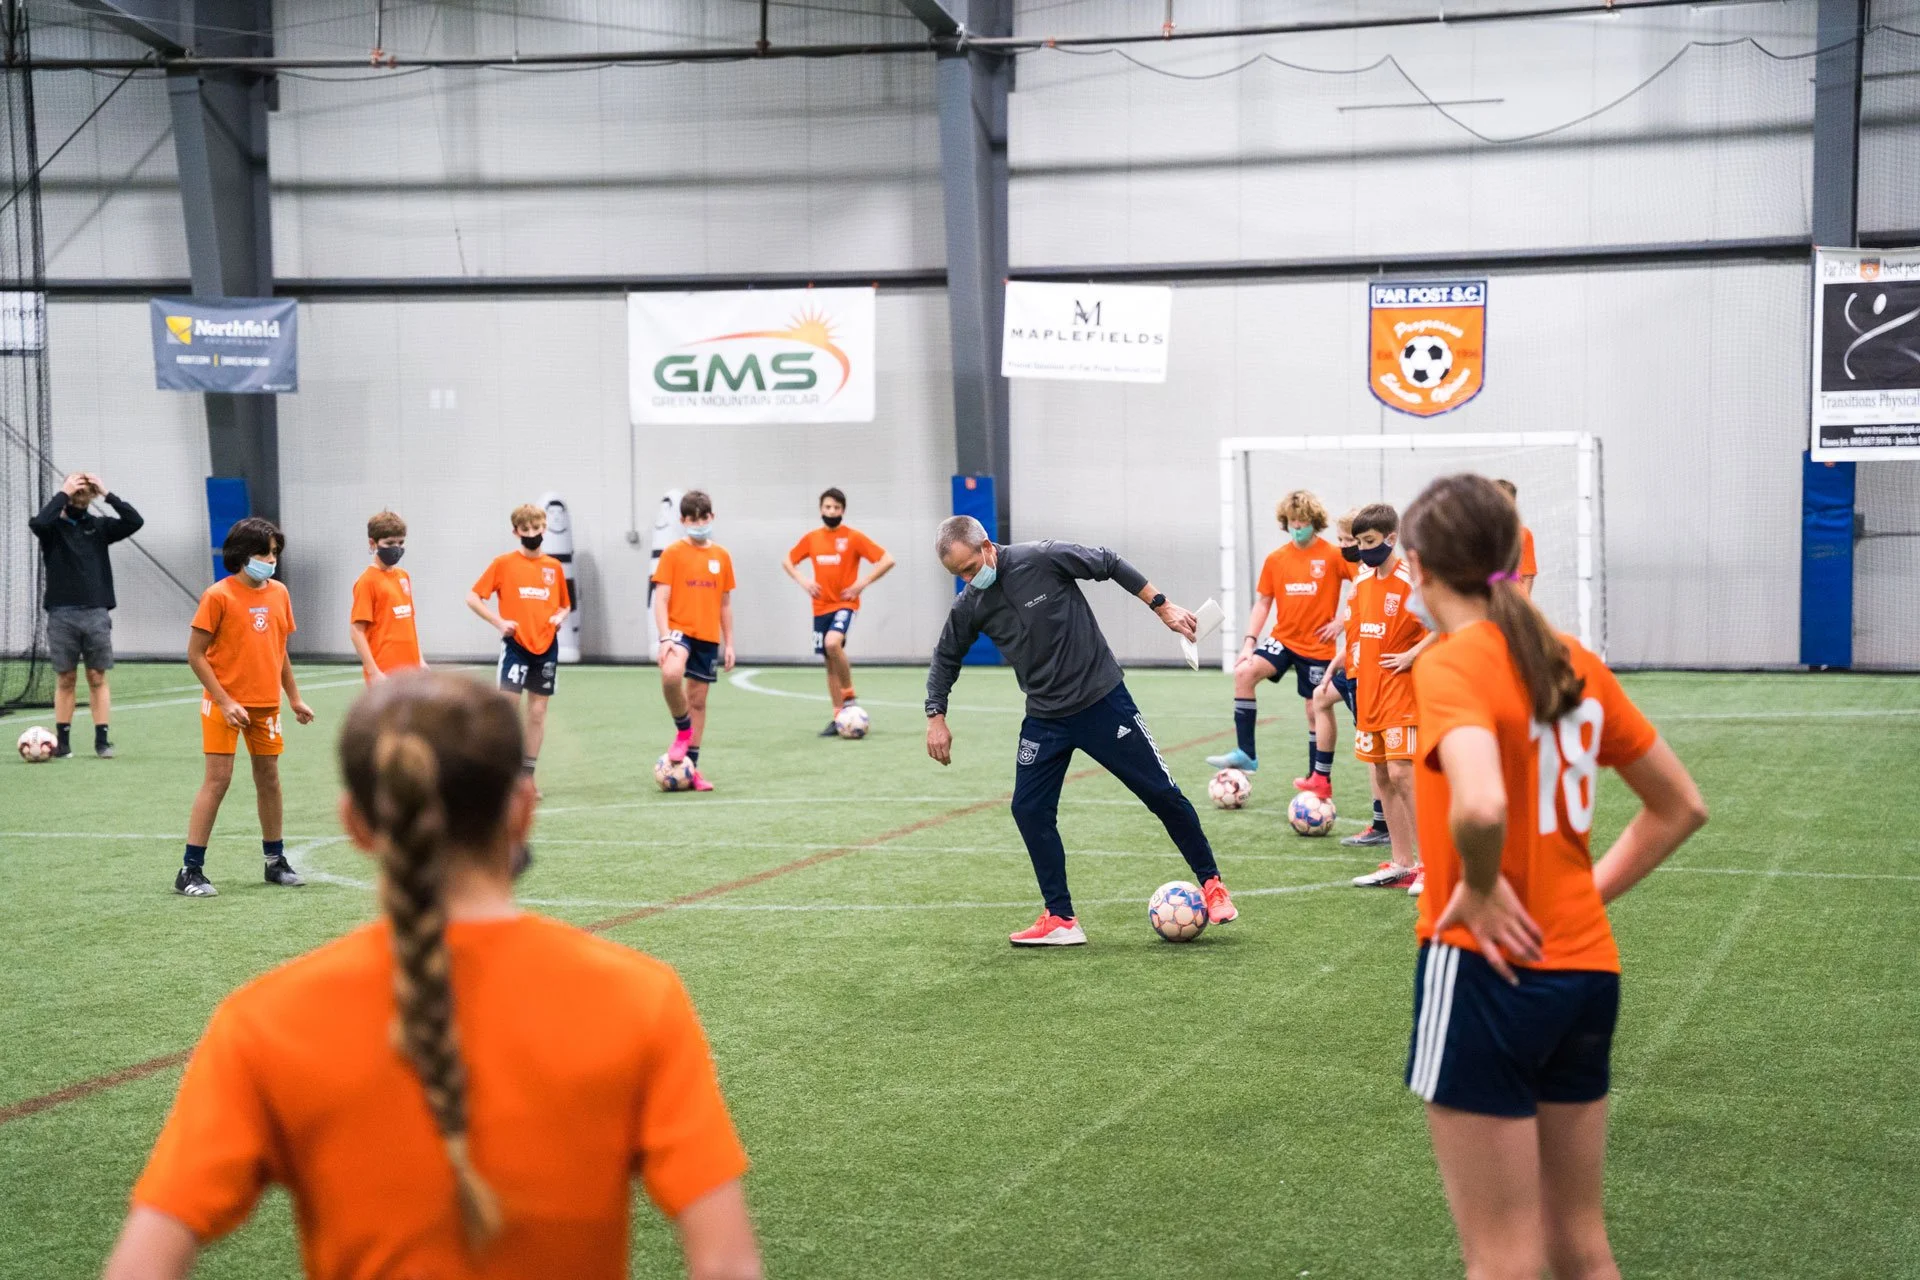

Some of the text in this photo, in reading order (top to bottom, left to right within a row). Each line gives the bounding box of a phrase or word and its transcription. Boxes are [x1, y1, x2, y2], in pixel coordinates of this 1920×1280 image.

[1375, 288, 1407, 303] FAR
[1408, 287, 1450, 302] POST
[194, 319, 281, 338] Northfield
[1011, 328, 1164, 345] MAPLEFIELDS
[654, 352, 817, 393] GMS
[651, 394, 820, 408] GREEN MOUNTAIN SOLAR
[1820, 394, 1876, 410] Transitions
[508, 663, 529, 686] 47
[1529, 697, 1605, 835] 18
